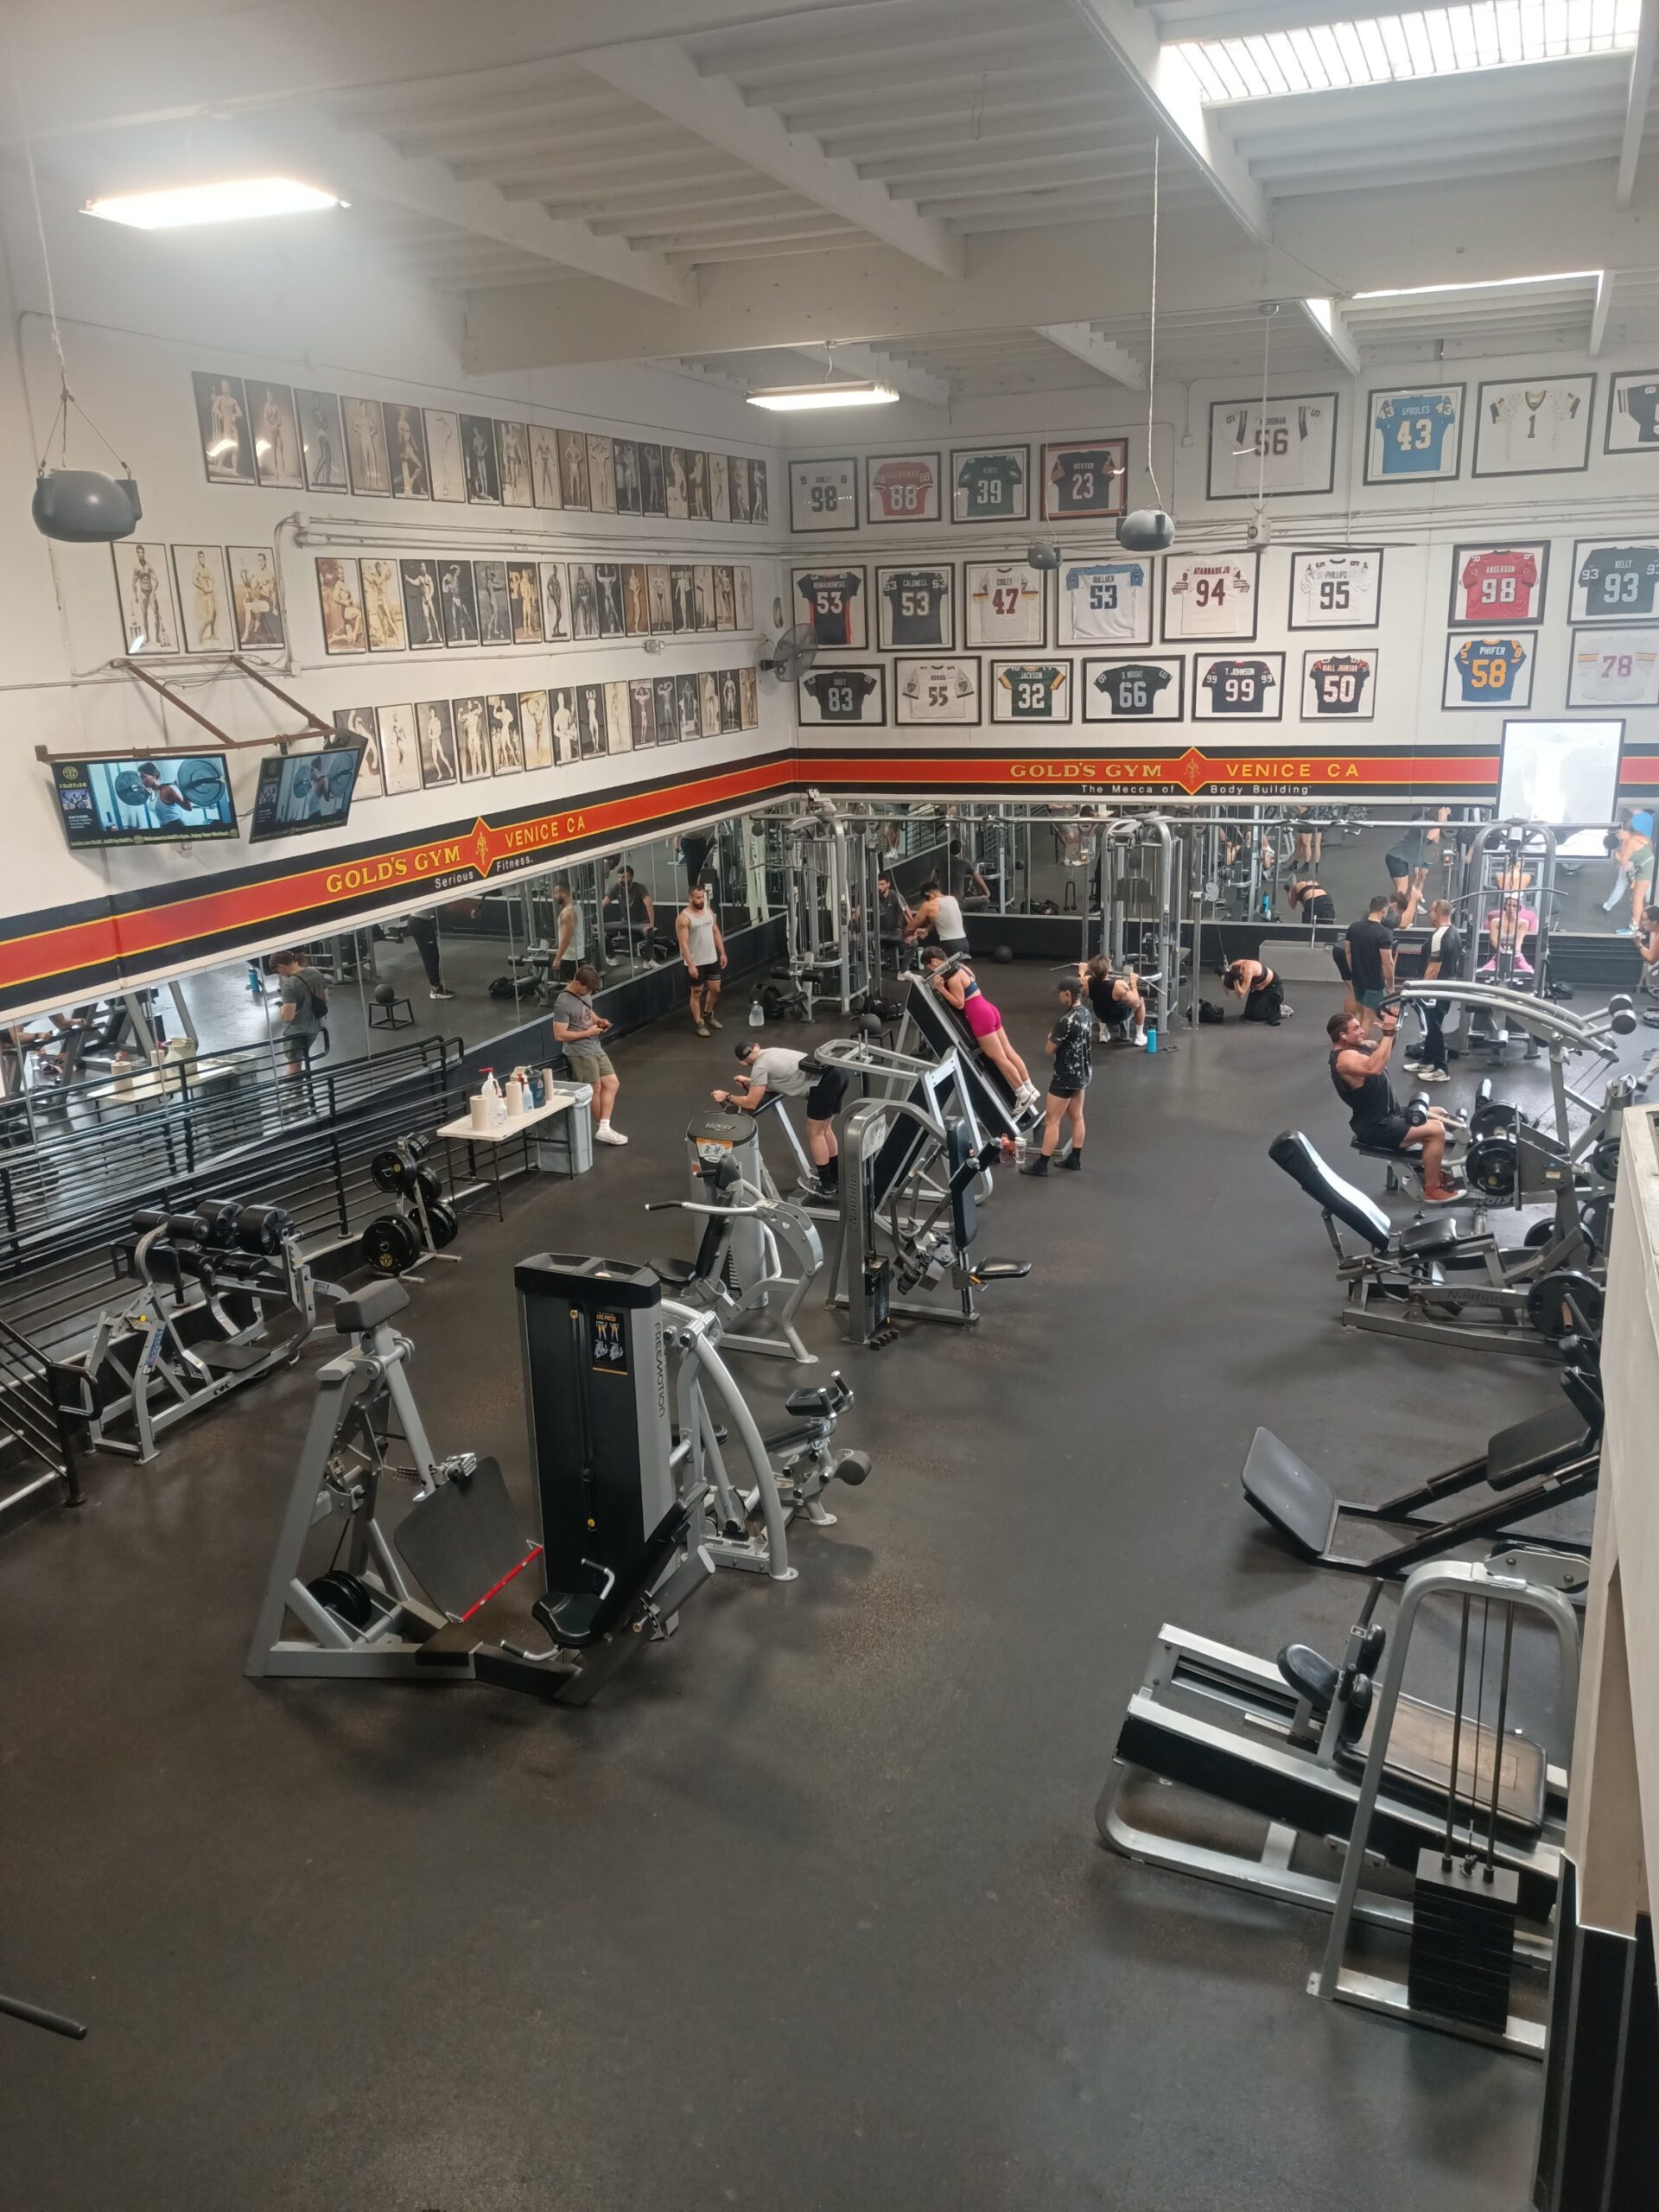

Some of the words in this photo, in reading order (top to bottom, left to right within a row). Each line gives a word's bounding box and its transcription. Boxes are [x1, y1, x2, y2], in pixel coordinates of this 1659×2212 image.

[1402, 405, 1431, 416] SPROLES
[1396, 418, 1433, 451] 43
[1528, 414, 1536, 439] 1
[1254, 429, 1289, 456] 56
[811, 486, 838, 512] 98
[891, 484, 918, 510] 88
[977, 480, 1002, 504] 39
[1072, 473, 1094, 500] 23
[1182, 573, 1188, 582] 9
[1234, 570, 1242, 580] 4
[1486, 565, 1516, 574] ANDERSON
[1582, 569, 1599, 581] 93
[1090, 585, 1118, 610] 53
[1196, 578, 1225, 607] 94
[1319, 581, 1350, 610] 95
[1481, 577, 1516, 604] 98
[1603, 572, 1640, 603] 93
[817, 591, 843, 614] 53
[901, 591, 931, 616] 53
[993, 588, 1019, 614] 47
[1479, 646, 1506, 656] PHIFER
[1206, 674, 1217, 683] 99
[1261, 674, 1273, 683] 99
[1471, 658, 1507, 688] 58
[1600, 655, 1633, 678] 78
[828, 687, 854, 712] 83
[928, 686, 948, 707] 55
[1018, 683, 1045, 709] 32
[1119, 681, 1147, 708] 66
[1225, 679, 1255, 702] 99
[1323, 675, 1357, 702] 50
[1010, 762, 1096, 778] GOLD'S
[1105, 764, 1162, 778] GYM
[1226, 763, 1311, 778] VENICE
[1326, 763, 1359, 777] CA
[1081, 785, 1103, 793] The
[1112, 785, 1153, 793] Mecca
[1162, 785, 1175, 793] of
[1211, 785, 1243, 796] Body
[326, 856, 408, 893] GOLD'S
[415, 845, 461, 871] GYM
[505, 822, 559, 849] VENICE
[567, 816, 586, 834] CA
[435, 870, 474, 889] Serious
